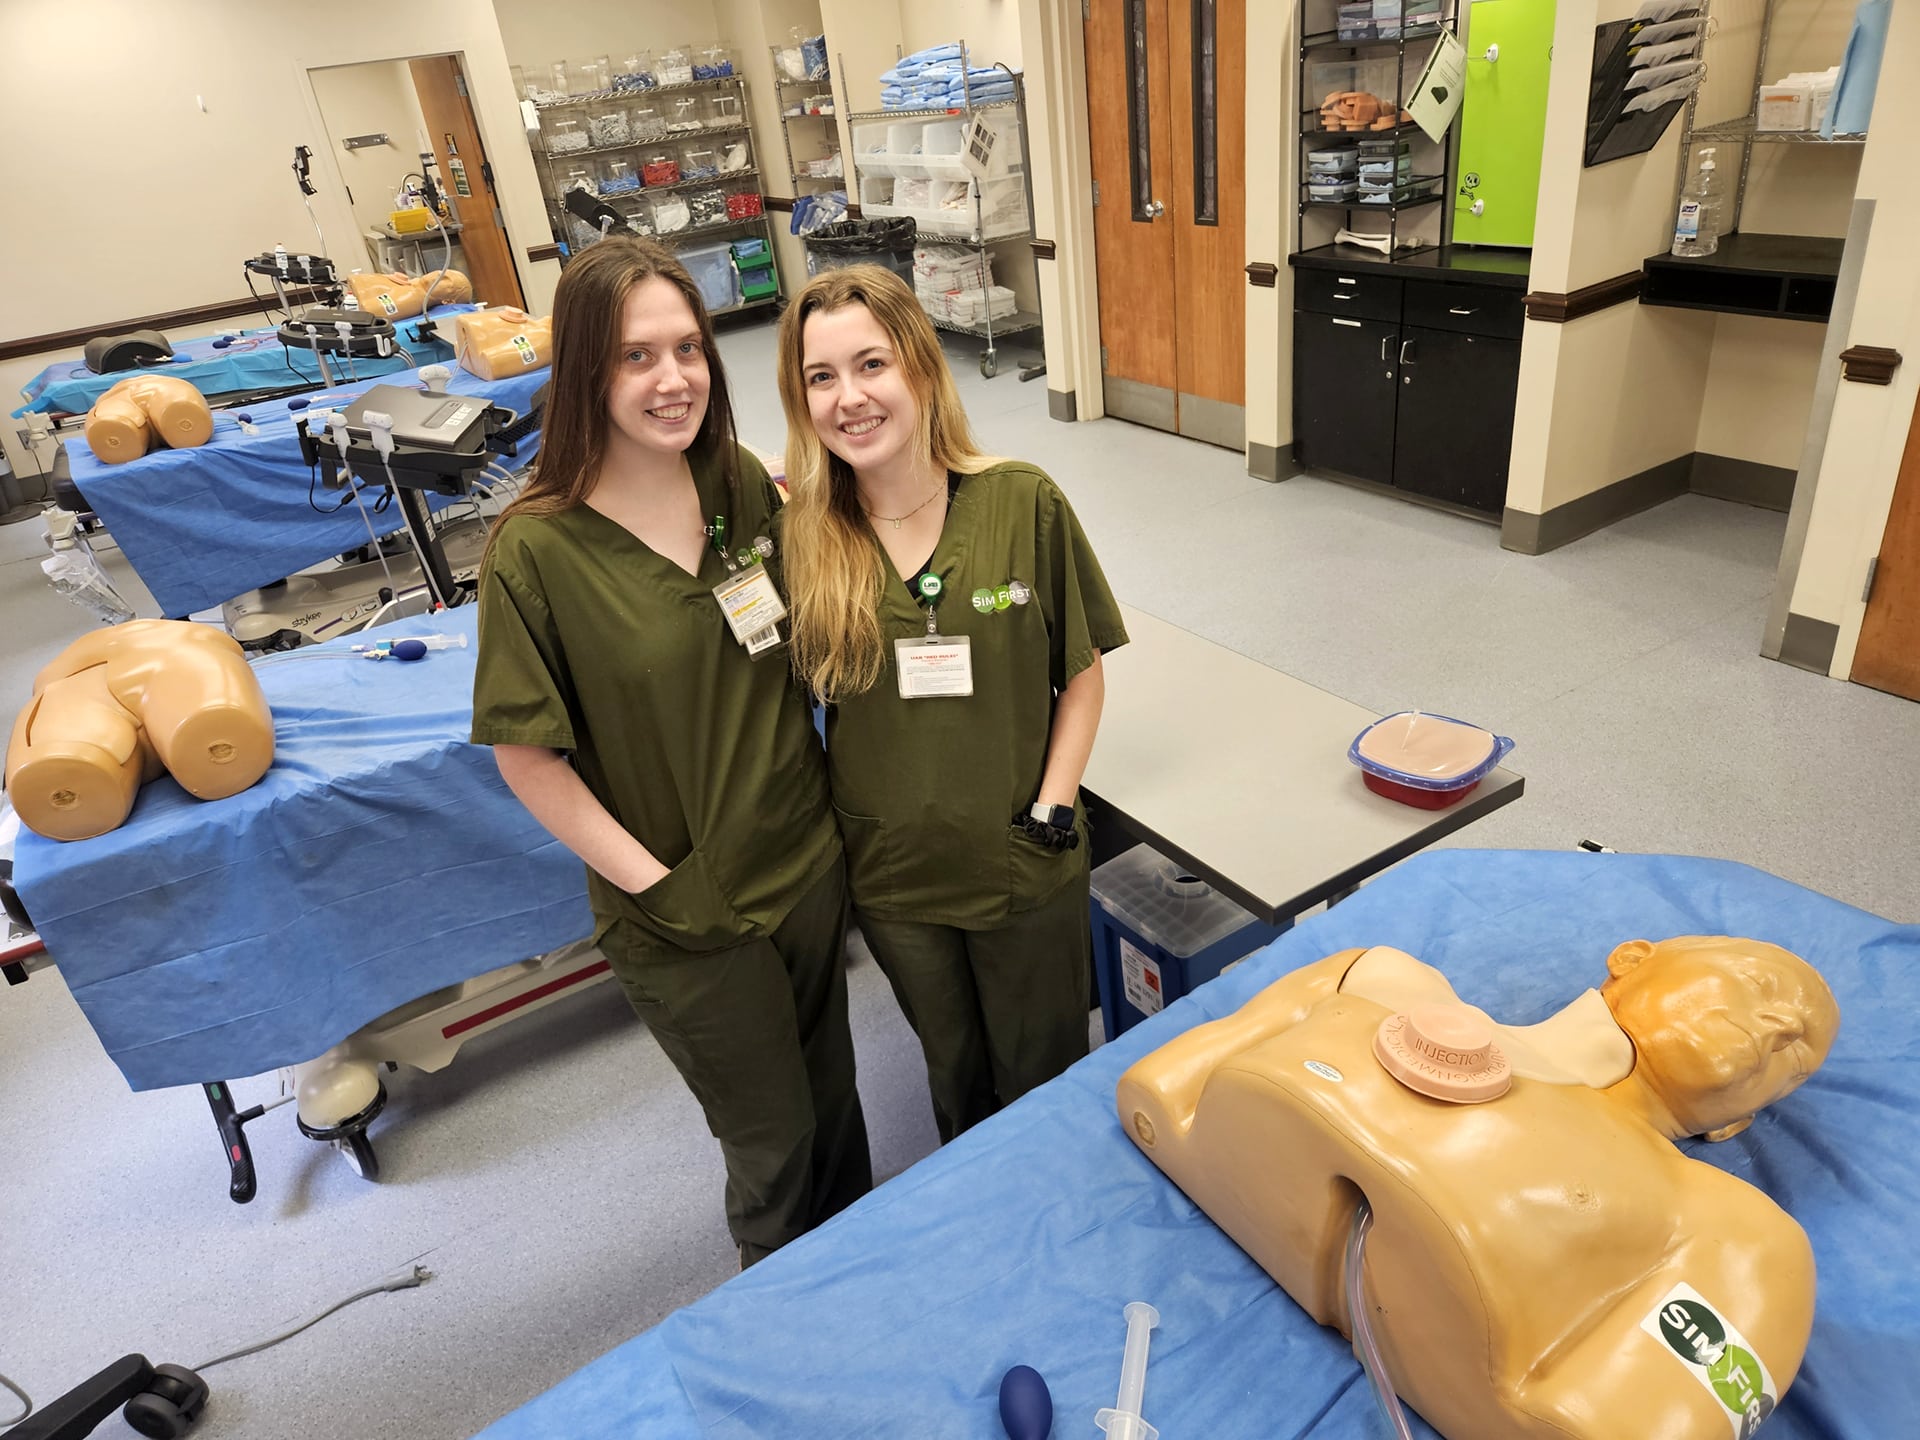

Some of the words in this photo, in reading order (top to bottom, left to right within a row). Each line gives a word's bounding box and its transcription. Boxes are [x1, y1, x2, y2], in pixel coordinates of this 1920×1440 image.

[972, 596, 996, 608] SIM
[998, 588, 1030, 603] FIRST
[1415, 1038, 1486, 1066] INJECTION
[1660, 1303, 1725, 1366] SIM
[1727, 1364, 1763, 1435] FIRS
